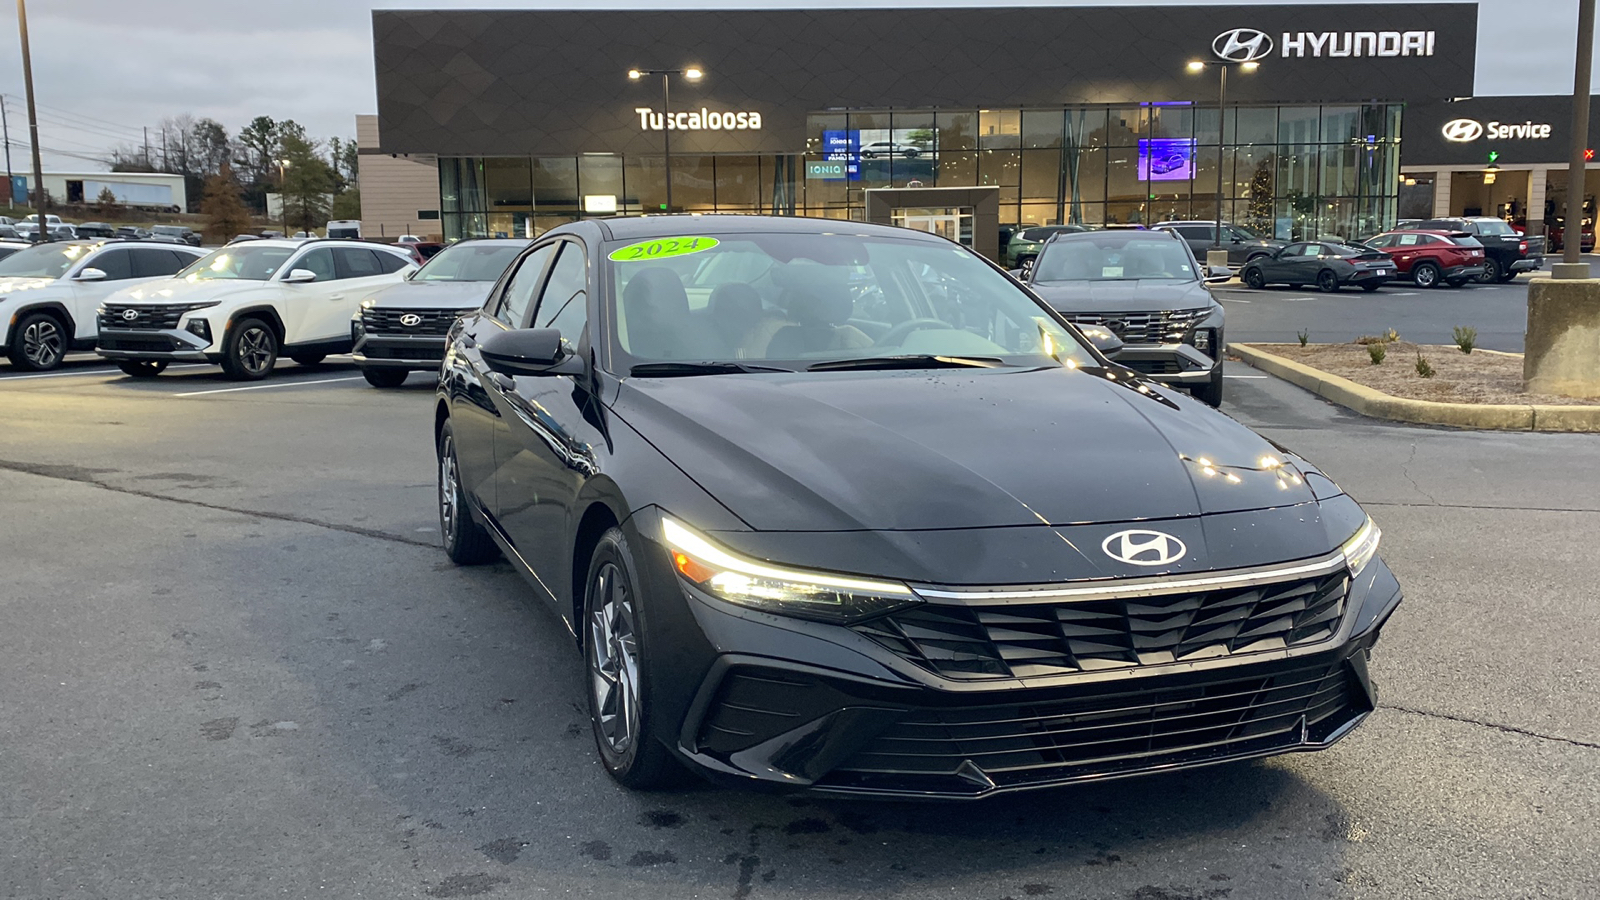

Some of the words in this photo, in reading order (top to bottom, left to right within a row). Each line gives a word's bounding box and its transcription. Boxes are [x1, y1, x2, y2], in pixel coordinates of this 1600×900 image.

[1281, 31, 1436, 58] HYUNDAI
[635, 107, 762, 130] Tuscaloosa
[1486, 121, 1552, 139] Service
[810, 165, 841, 174] IONIQ
[629, 238, 699, 259] 2024
